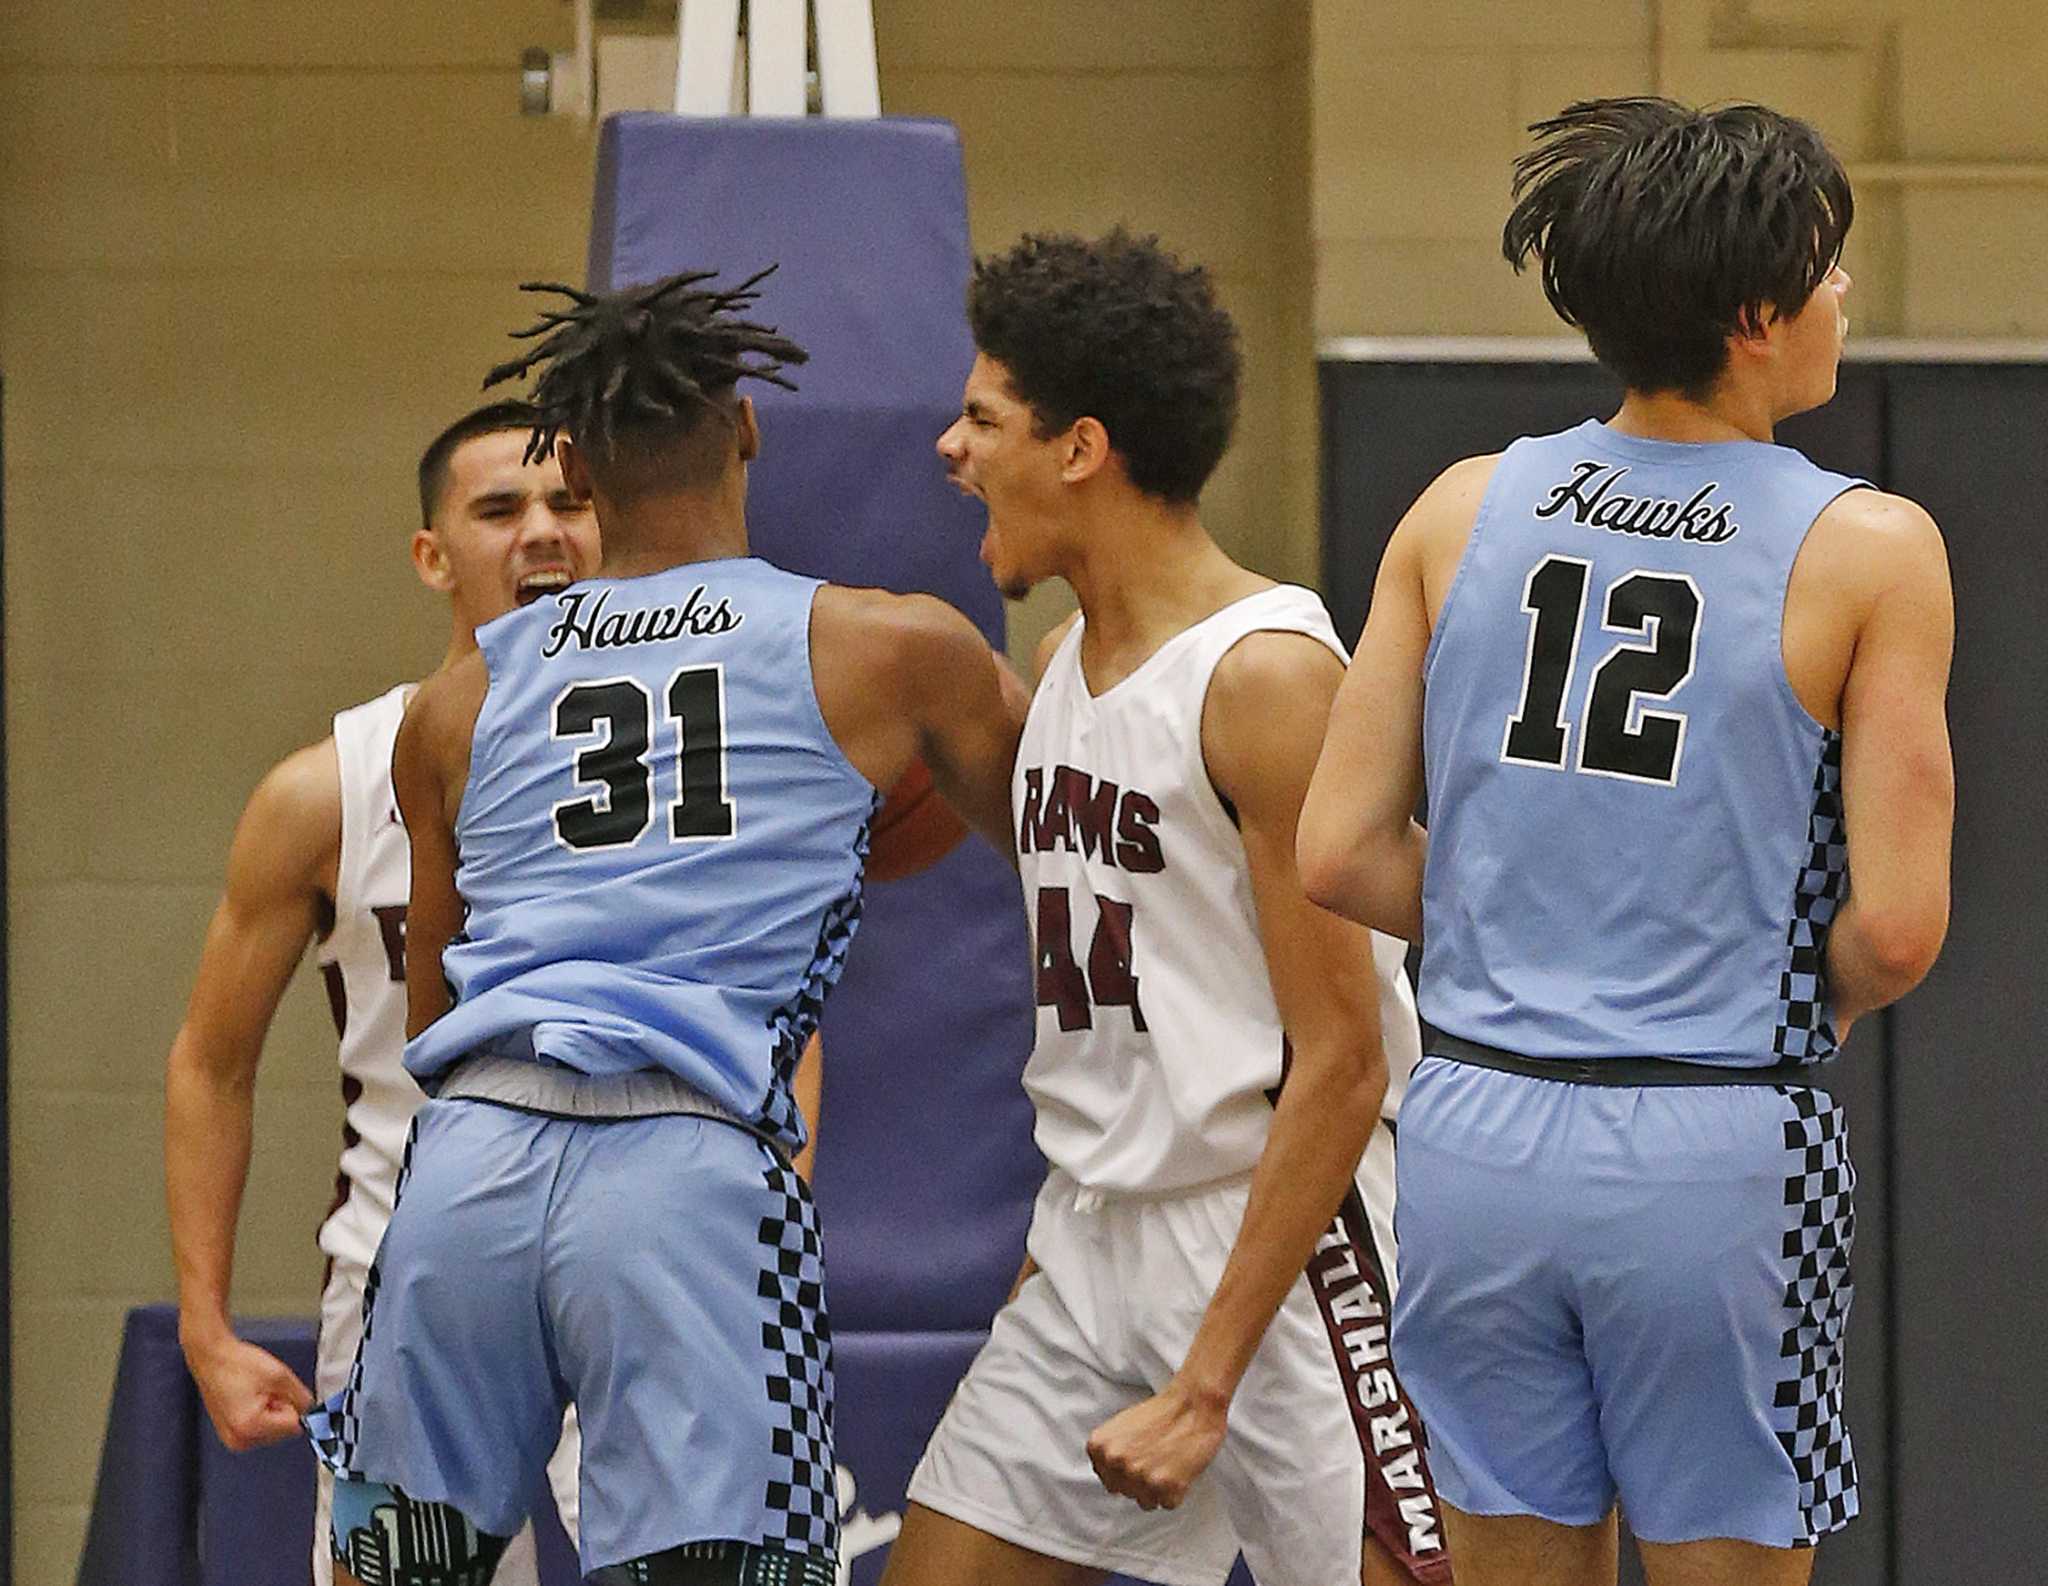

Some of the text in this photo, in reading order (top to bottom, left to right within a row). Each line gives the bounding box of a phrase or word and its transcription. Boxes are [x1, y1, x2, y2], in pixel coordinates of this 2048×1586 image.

[1534, 461, 1739, 545] Hawks
[541, 584, 743, 659] Hawks
[1500, 553, 1705, 788] 12
[551, 663, 737, 851] 31
[1020, 764, 1166, 873] RAMS
[1037, 887, 1148, 1032] 44
[1314, 1215, 1442, 1557] MARSHALL
